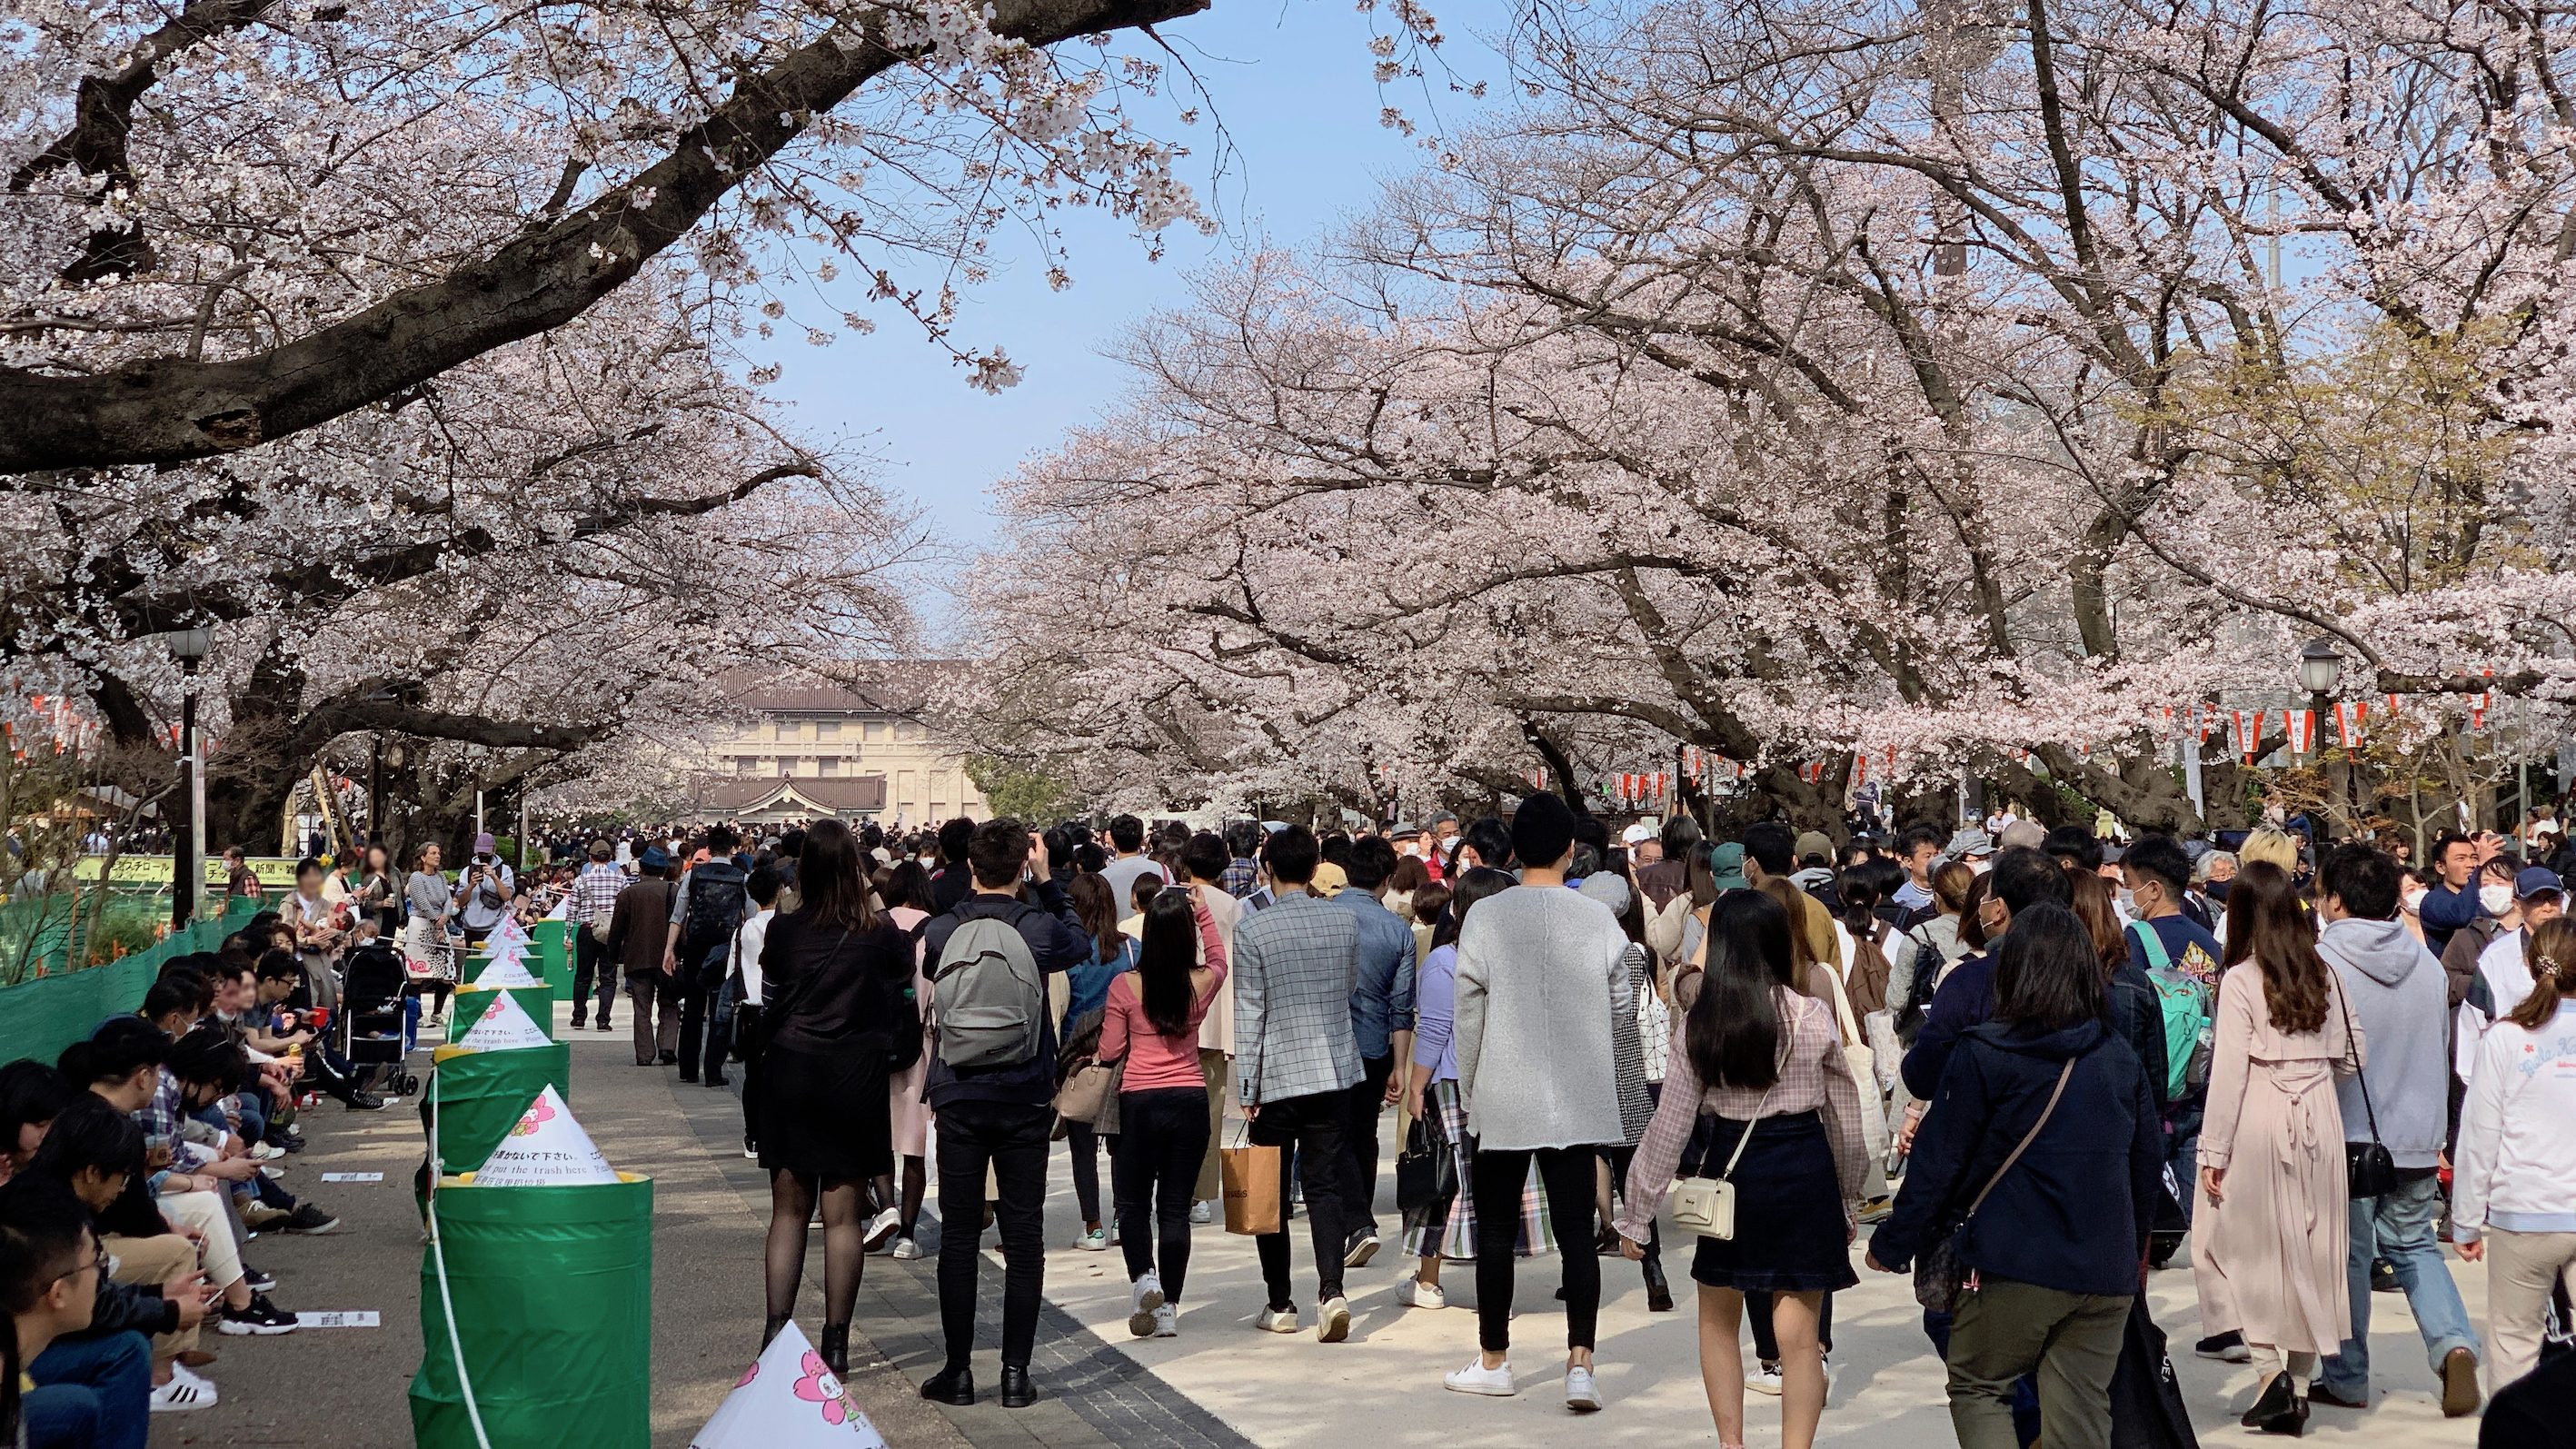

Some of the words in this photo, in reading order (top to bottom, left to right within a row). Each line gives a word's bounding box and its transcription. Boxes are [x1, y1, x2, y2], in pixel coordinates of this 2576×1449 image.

[492, 1166, 507, 1175] put
[512, 1165, 528, 1174] the
[533, 1166, 562, 1175] trash
[565, 1166, 587, 1174] here
